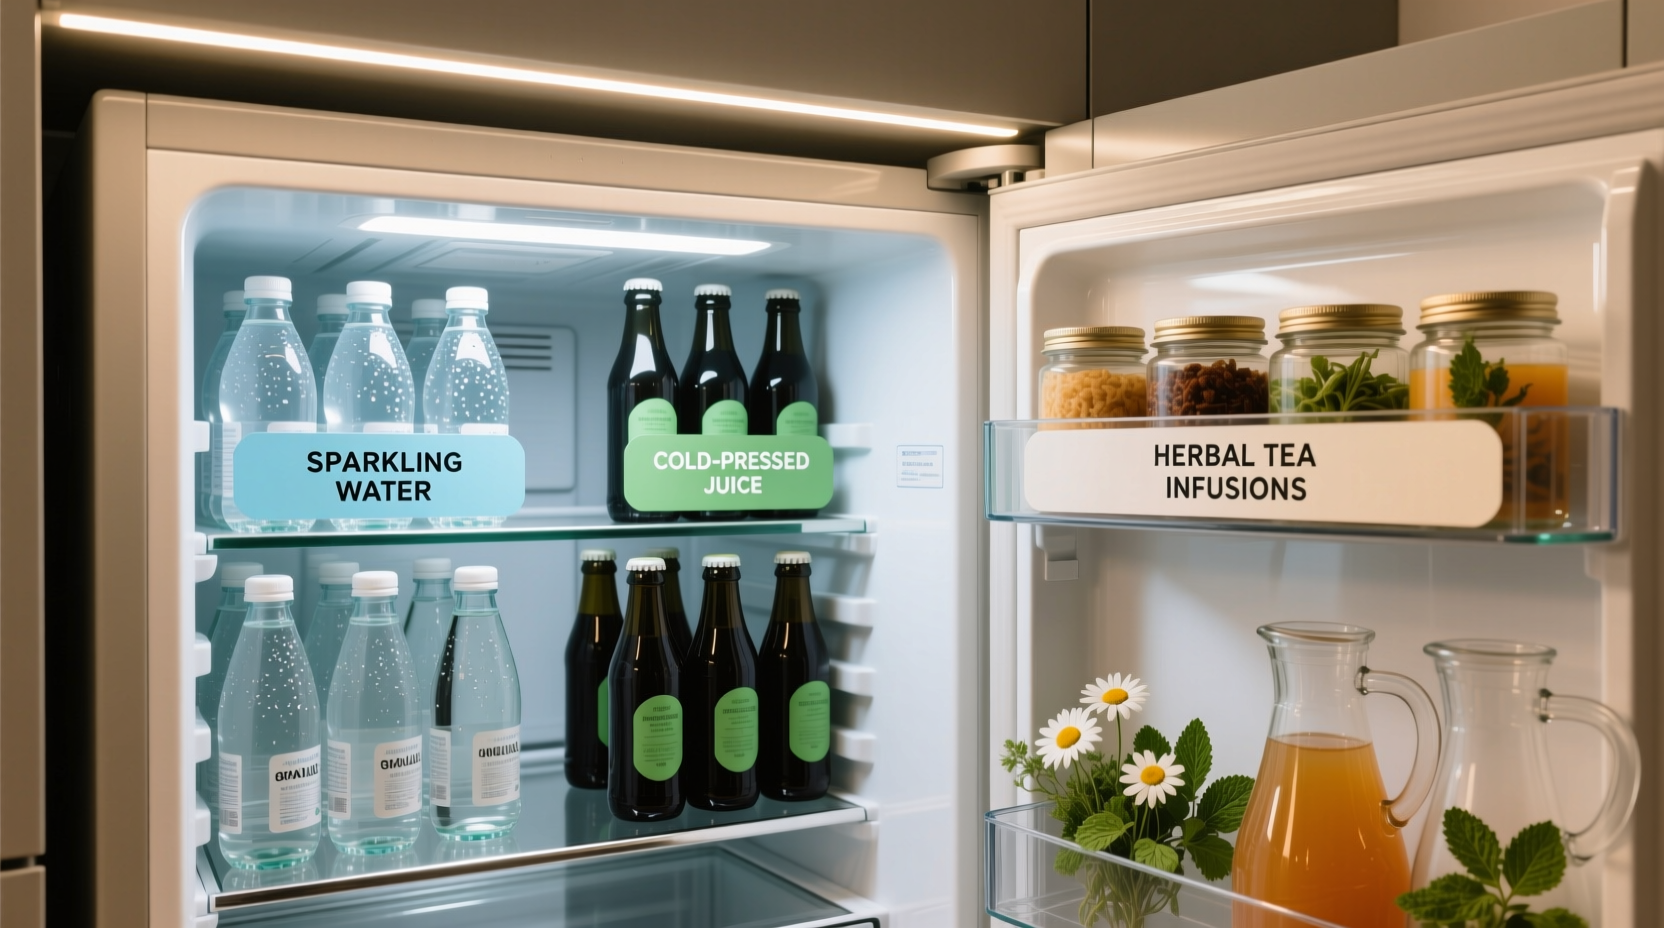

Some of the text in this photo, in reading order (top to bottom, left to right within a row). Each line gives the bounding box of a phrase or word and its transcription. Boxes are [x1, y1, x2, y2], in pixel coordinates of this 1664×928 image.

[306, 450, 463, 473] SPARKLING
[653, 451, 810, 470] COLD-PRESSED
[1154, 442, 1317, 468] HERBAL TEA
[335, 480, 432, 502] WATER
[703, 475, 763, 495] JUICE
[1165, 476, 1308, 501] INFUSIONS
